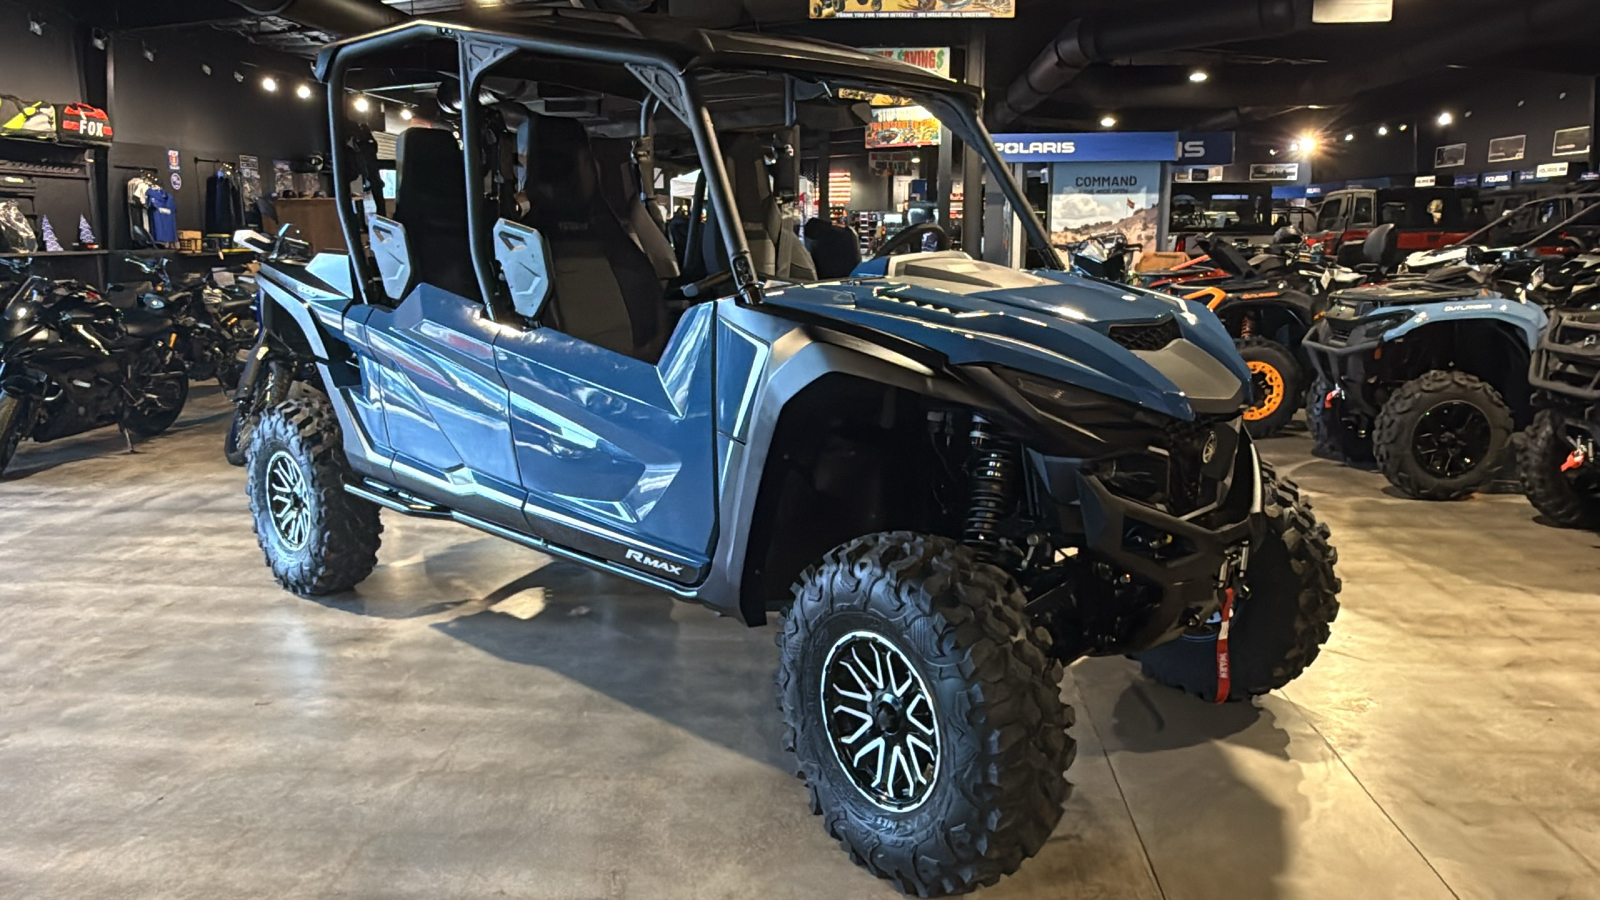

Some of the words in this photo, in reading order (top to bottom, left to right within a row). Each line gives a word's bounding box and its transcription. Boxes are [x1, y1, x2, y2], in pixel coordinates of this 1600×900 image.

[79, 119, 104, 137] FOX
[994, 141, 1076, 154] POLARIS
[1075, 175, 1138, 187] COMMAND
[1484, 174, 1508, 183] POLARIS
